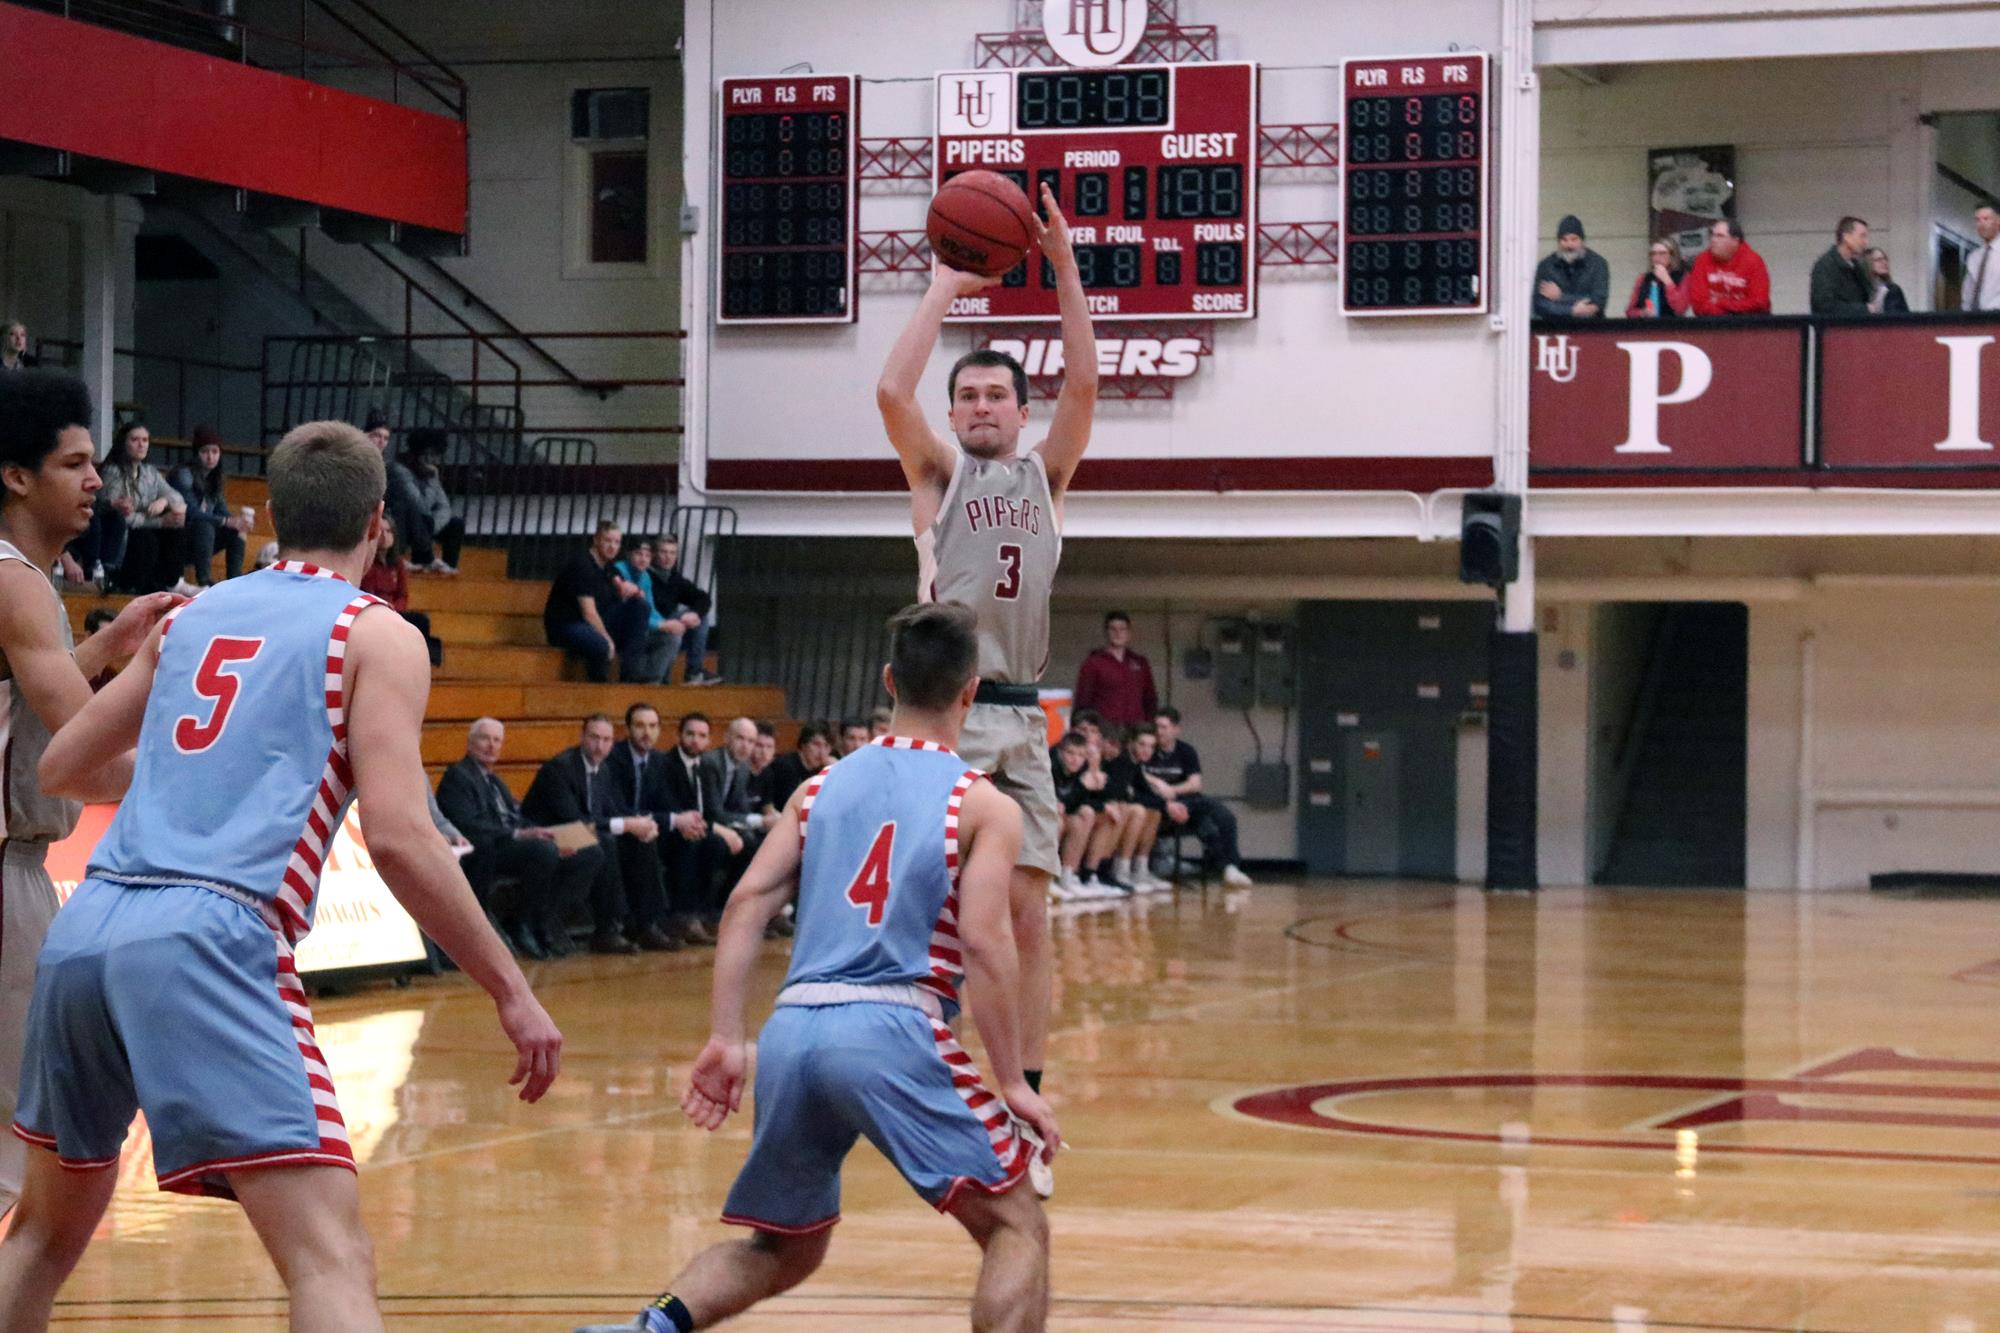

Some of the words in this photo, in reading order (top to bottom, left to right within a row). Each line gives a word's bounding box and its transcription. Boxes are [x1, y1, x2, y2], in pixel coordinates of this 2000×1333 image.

[1355, 69, 1388, 86] PLYR
[1401, 67, 1425, 84] FLS
[1442, 64, 1469, 83] PTS
[733, 88, 761, 104] PLYR
[775, 86, 797, 102] FLS
[813, 85, 836, 102] PTS
[954, 80, 996, 128] HU
[946, 139, 1025, 164] PIPERS
[1161, 133, 1237, 159] GUEST
[1064, 150, 1121, 168] PERIOD
[1068, 227, 1096, 244] YER
[1106, 226, 1146, 243] FOUL
[1193, 224, 1245, 241] FOULS
[946, 298, 989, 314] CORE
[1087, 296, 1119, 312] TCH
[1192, 294, 1244, 311] SCORE
[1535, 335, 1580, 382] HU
[1614, 341, 1713, 453] P
[1934, 335, 1996, 451] I
[965, 495, 1041, 536] PIPERS
[994, 543, 1023, 601] 3
[173, 635, 266, 755] 5
[844, 820, 897, 928] 4
